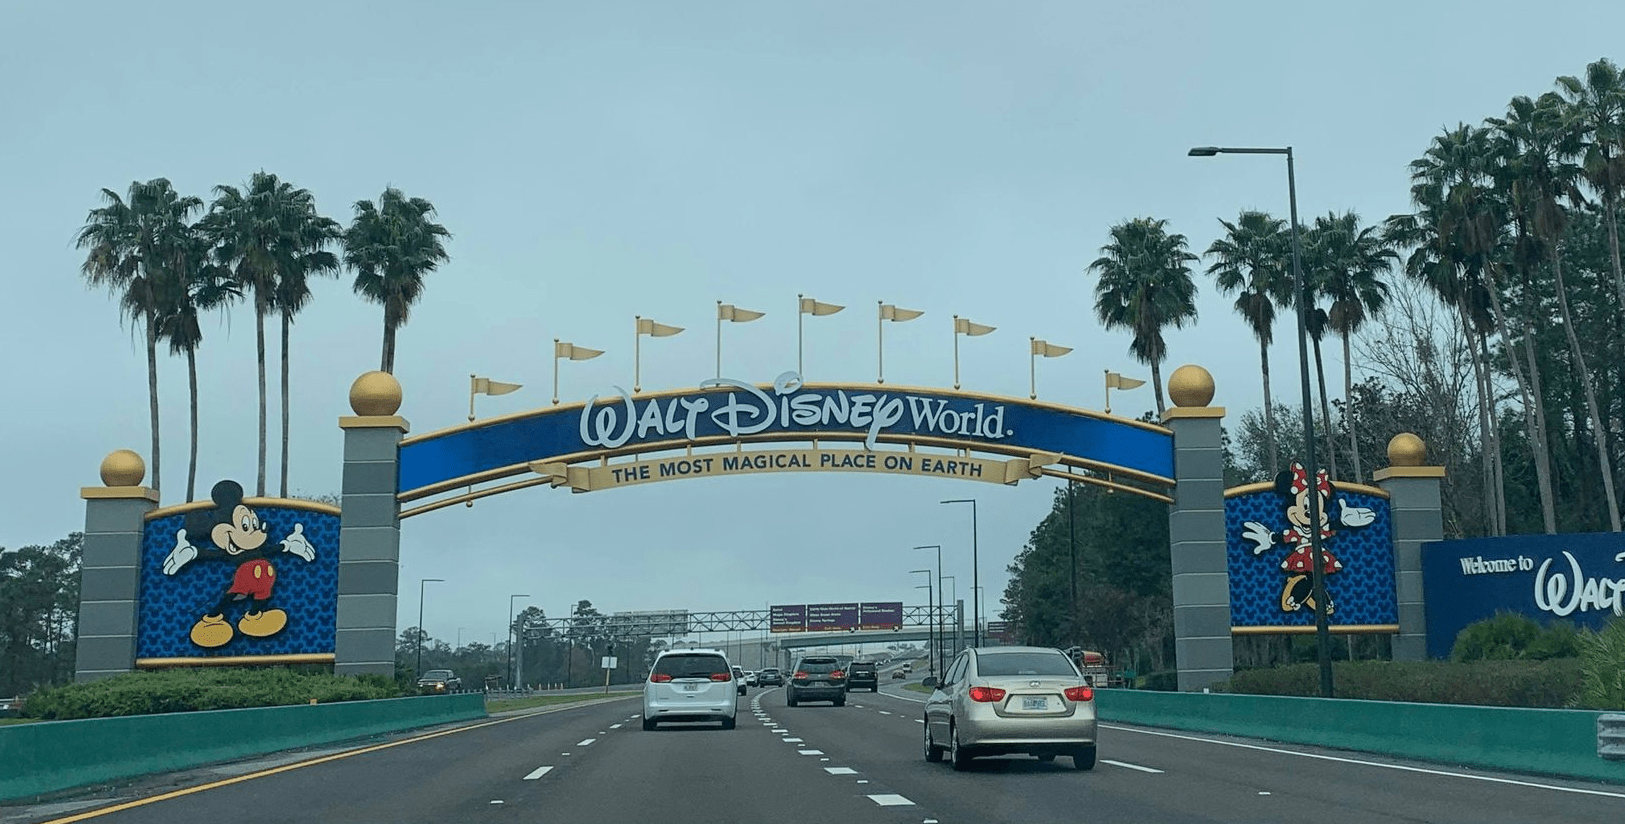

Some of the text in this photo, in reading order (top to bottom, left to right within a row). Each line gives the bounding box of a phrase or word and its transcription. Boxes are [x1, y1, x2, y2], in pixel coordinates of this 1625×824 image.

[612, 453, 983, 484] THE MOST MAGICAL PLACE ON EARTH
[1460, 554, 1533, 575] Welcome to
